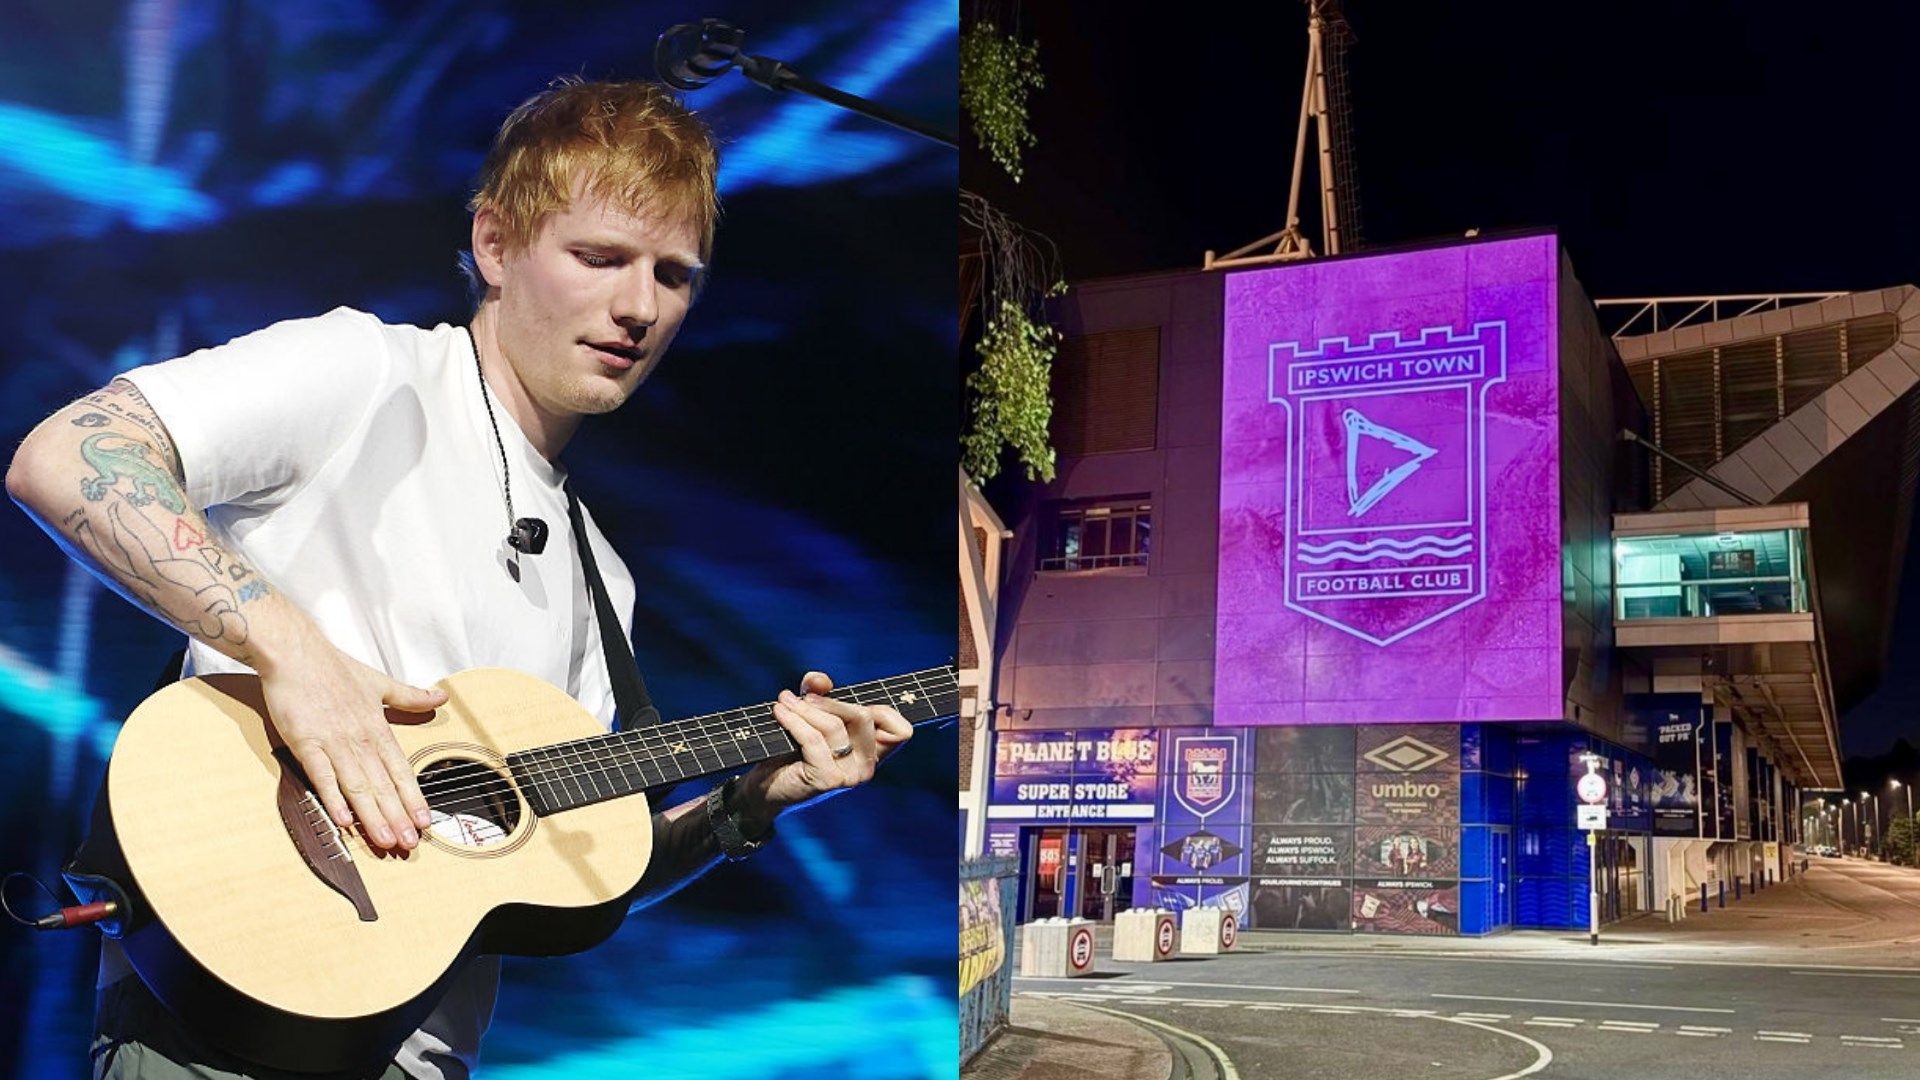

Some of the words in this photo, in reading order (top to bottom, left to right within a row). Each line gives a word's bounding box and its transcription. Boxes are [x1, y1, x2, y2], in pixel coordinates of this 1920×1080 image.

[1297, 362, 1394, 387] IPSWICH
[1401, 354, 1475, 377] TOWN
[1306, 573, 1404, 593] FOOTBALL
[1411, 571, 1462, 588] CLUB
[1010, 741, 1091, 762] PLANET
[1017, 784, 1071, 800] SUPER
[1075, 783, 1129, 799] STORE
[1371, 781, 1440, 798] umbro
[1038, 804, 1106, 818] ENTRANCE
[1270, 837, 1302, 845] ALWAYS
[1267, 846, 1299, 854] ALWAYS
[1265, 856, 1298, 864] ALWAYS
[1377, 881, 1404, 889] ALWAYS
